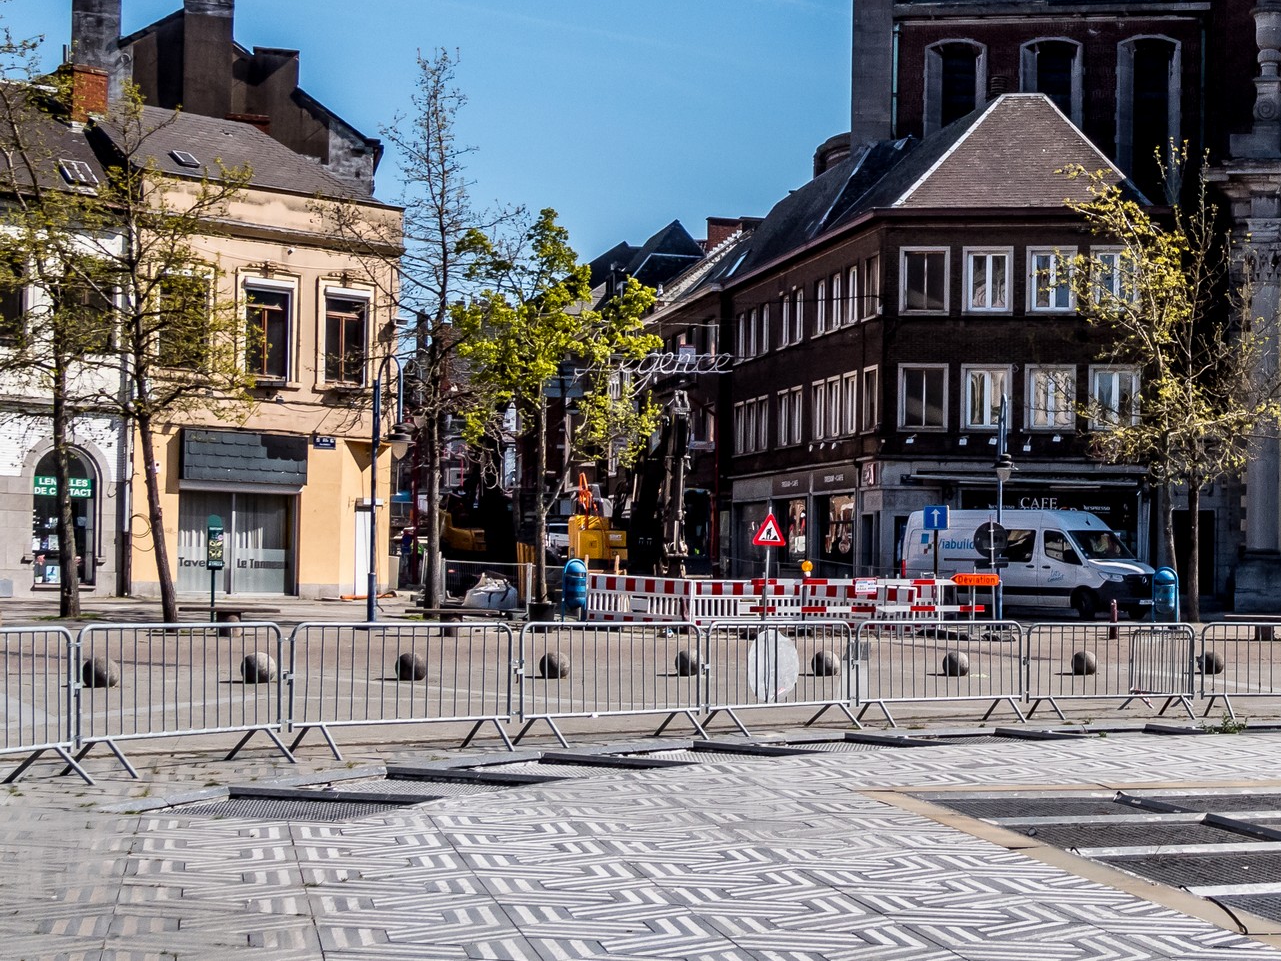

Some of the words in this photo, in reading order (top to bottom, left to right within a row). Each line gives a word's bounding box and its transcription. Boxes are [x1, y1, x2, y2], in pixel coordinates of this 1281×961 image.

[39, 477, 88, 487] LENLES
[34, 486, 47, 494] DE
[49, 487, 91, 496] CTACT
[178, 557, 225, 568] Tave
[237, 558, 247, 568] Le
